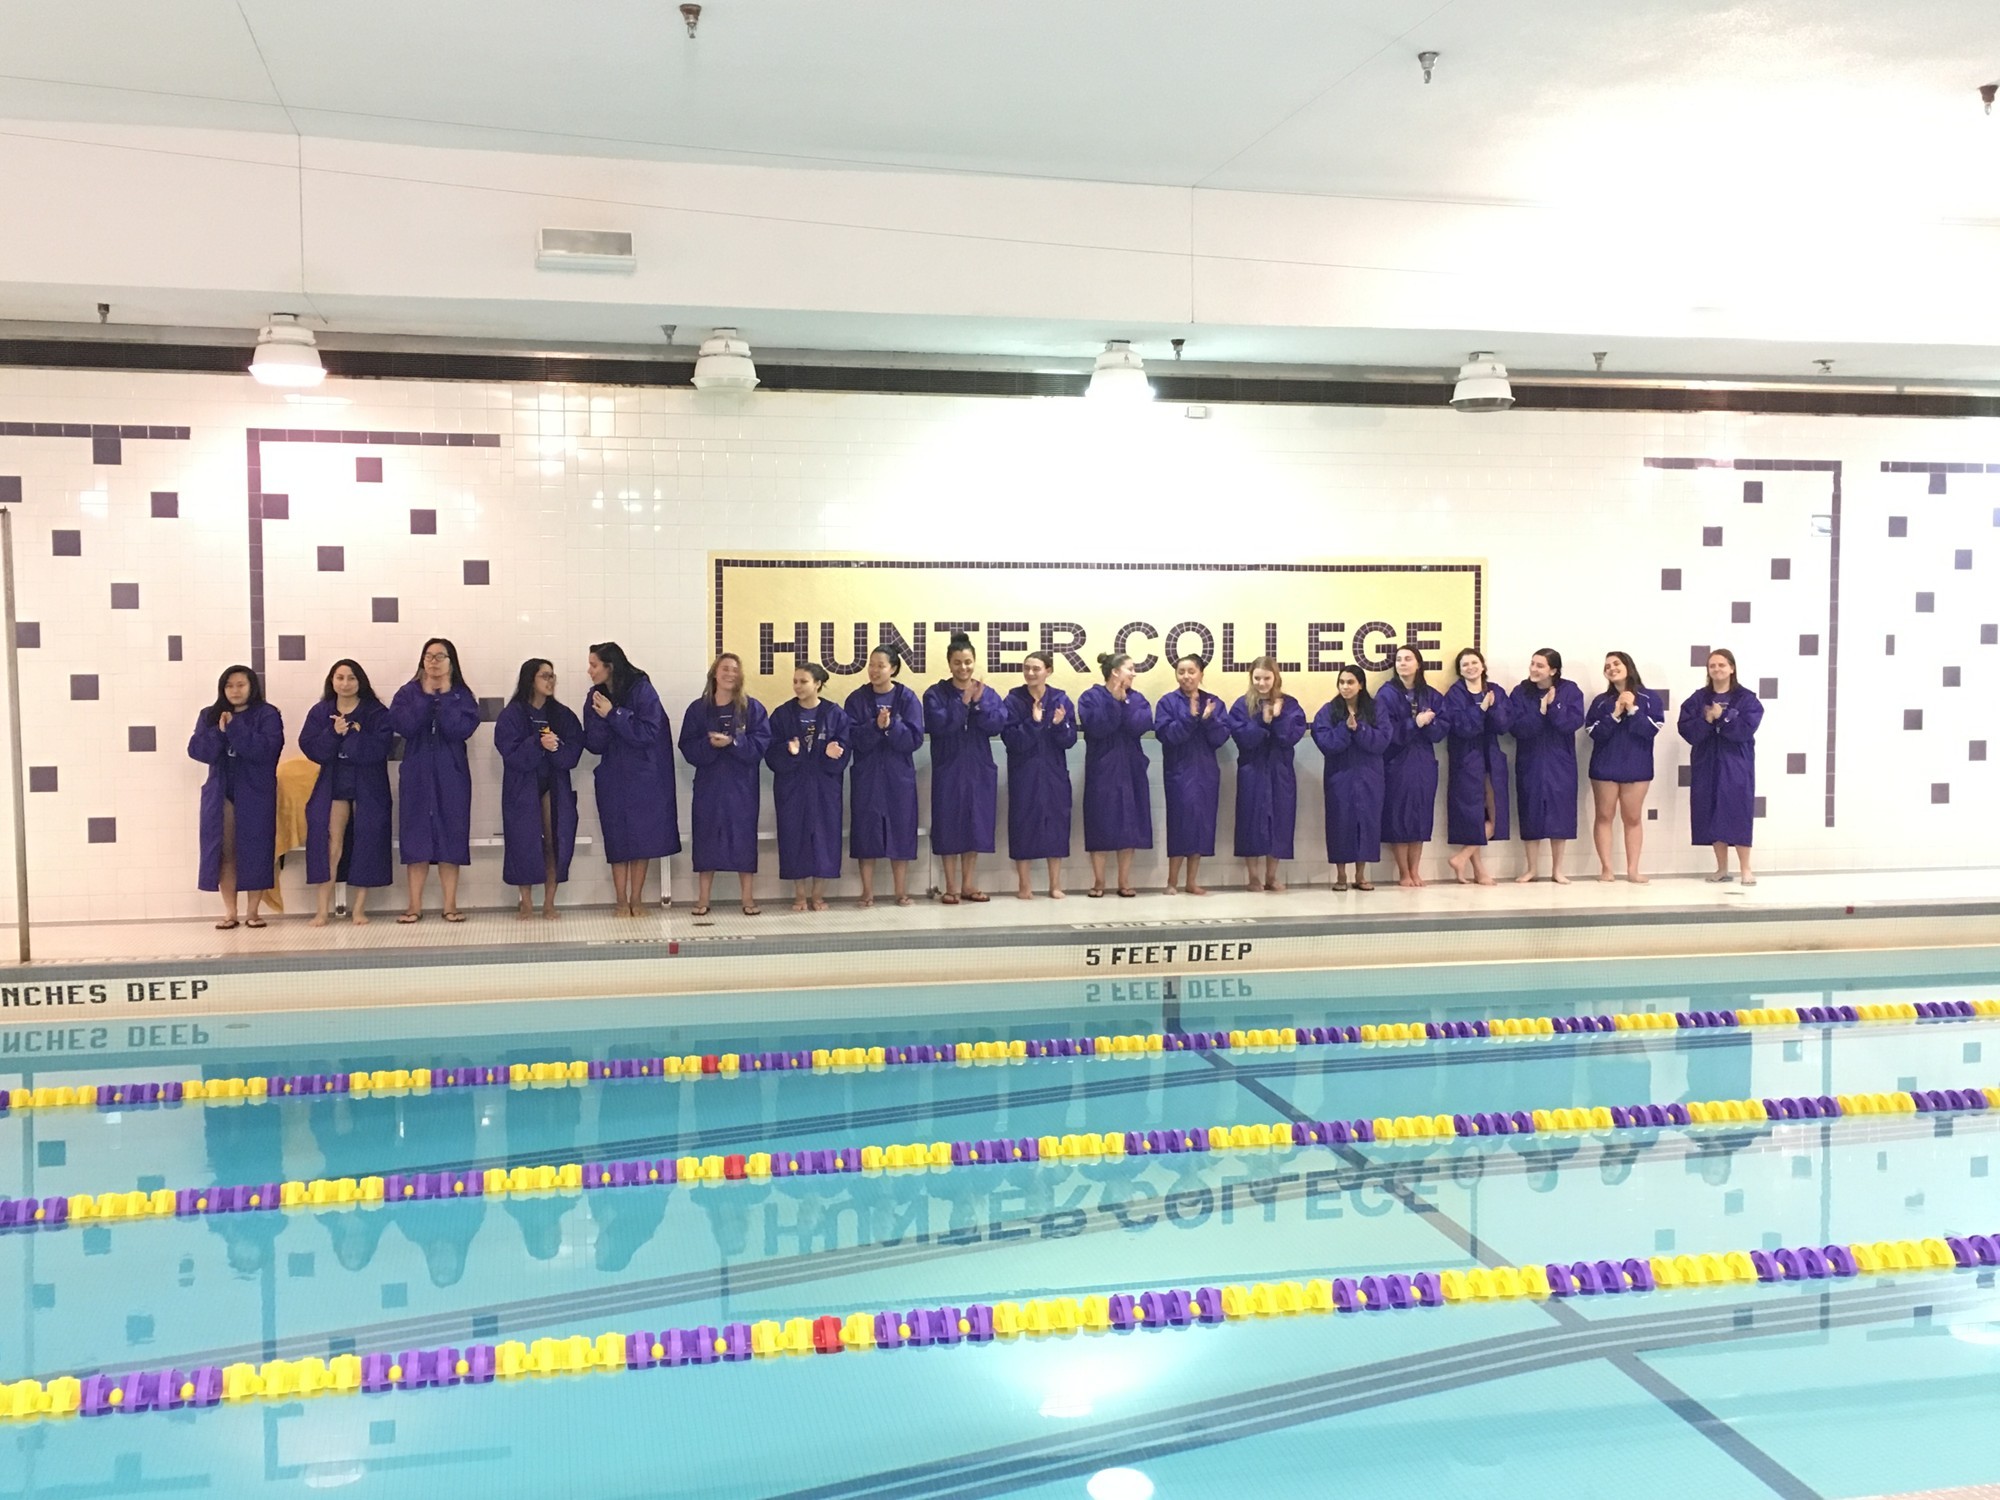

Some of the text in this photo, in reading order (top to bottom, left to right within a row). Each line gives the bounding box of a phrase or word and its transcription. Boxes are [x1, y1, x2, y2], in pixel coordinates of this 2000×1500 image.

[759, 620, 1443, 675] HUNTER COLLEGE
[1086, 942, 1253, 966] 5 FEET DEEP
[126, 979, 209, 1003] DEEP
